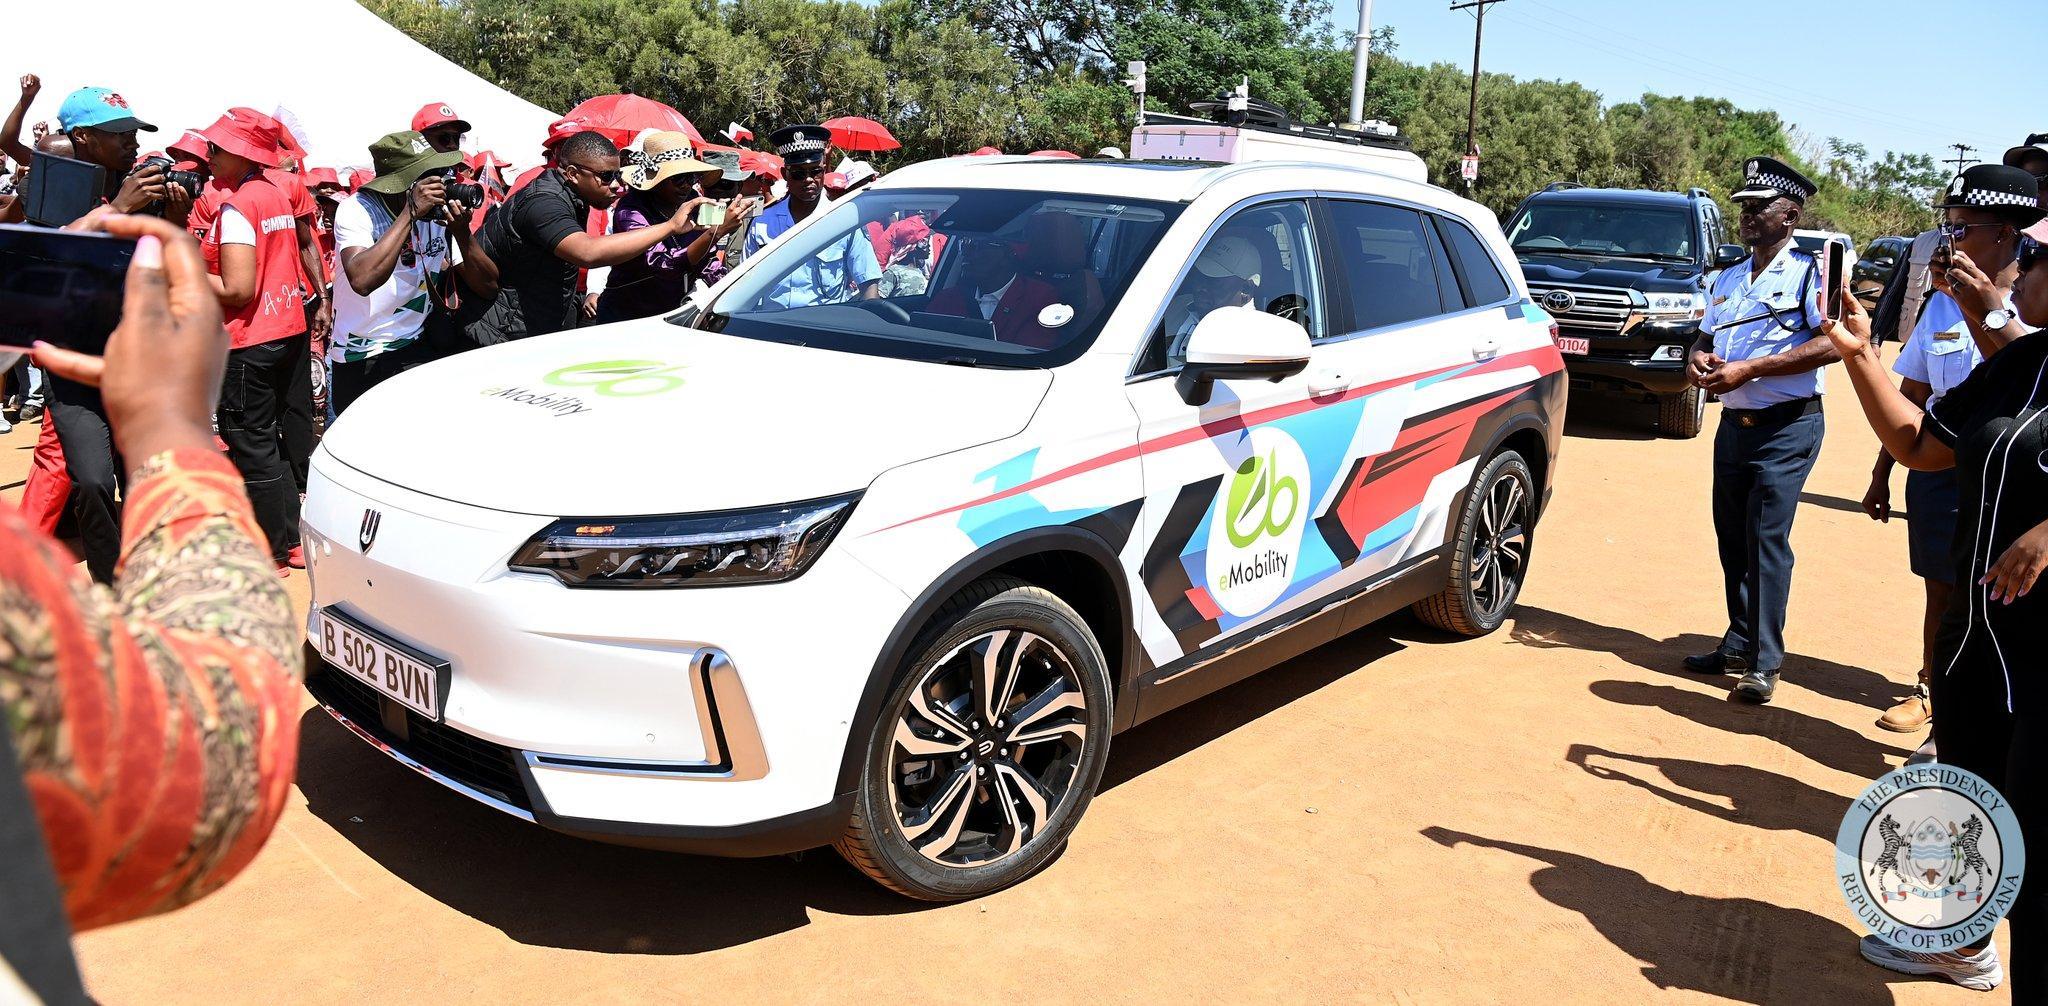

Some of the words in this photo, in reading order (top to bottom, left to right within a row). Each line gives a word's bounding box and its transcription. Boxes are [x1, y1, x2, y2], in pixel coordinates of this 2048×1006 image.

[1558, 338, 1587, 352] 0104
[480, 386, 593, 417] eMobility
[1219, 549, 1289, 592] eMobility
[324, 619, 336, 658] B
[343, 633, 378, 682] 502
[384, 652, 430, 710] BVN
